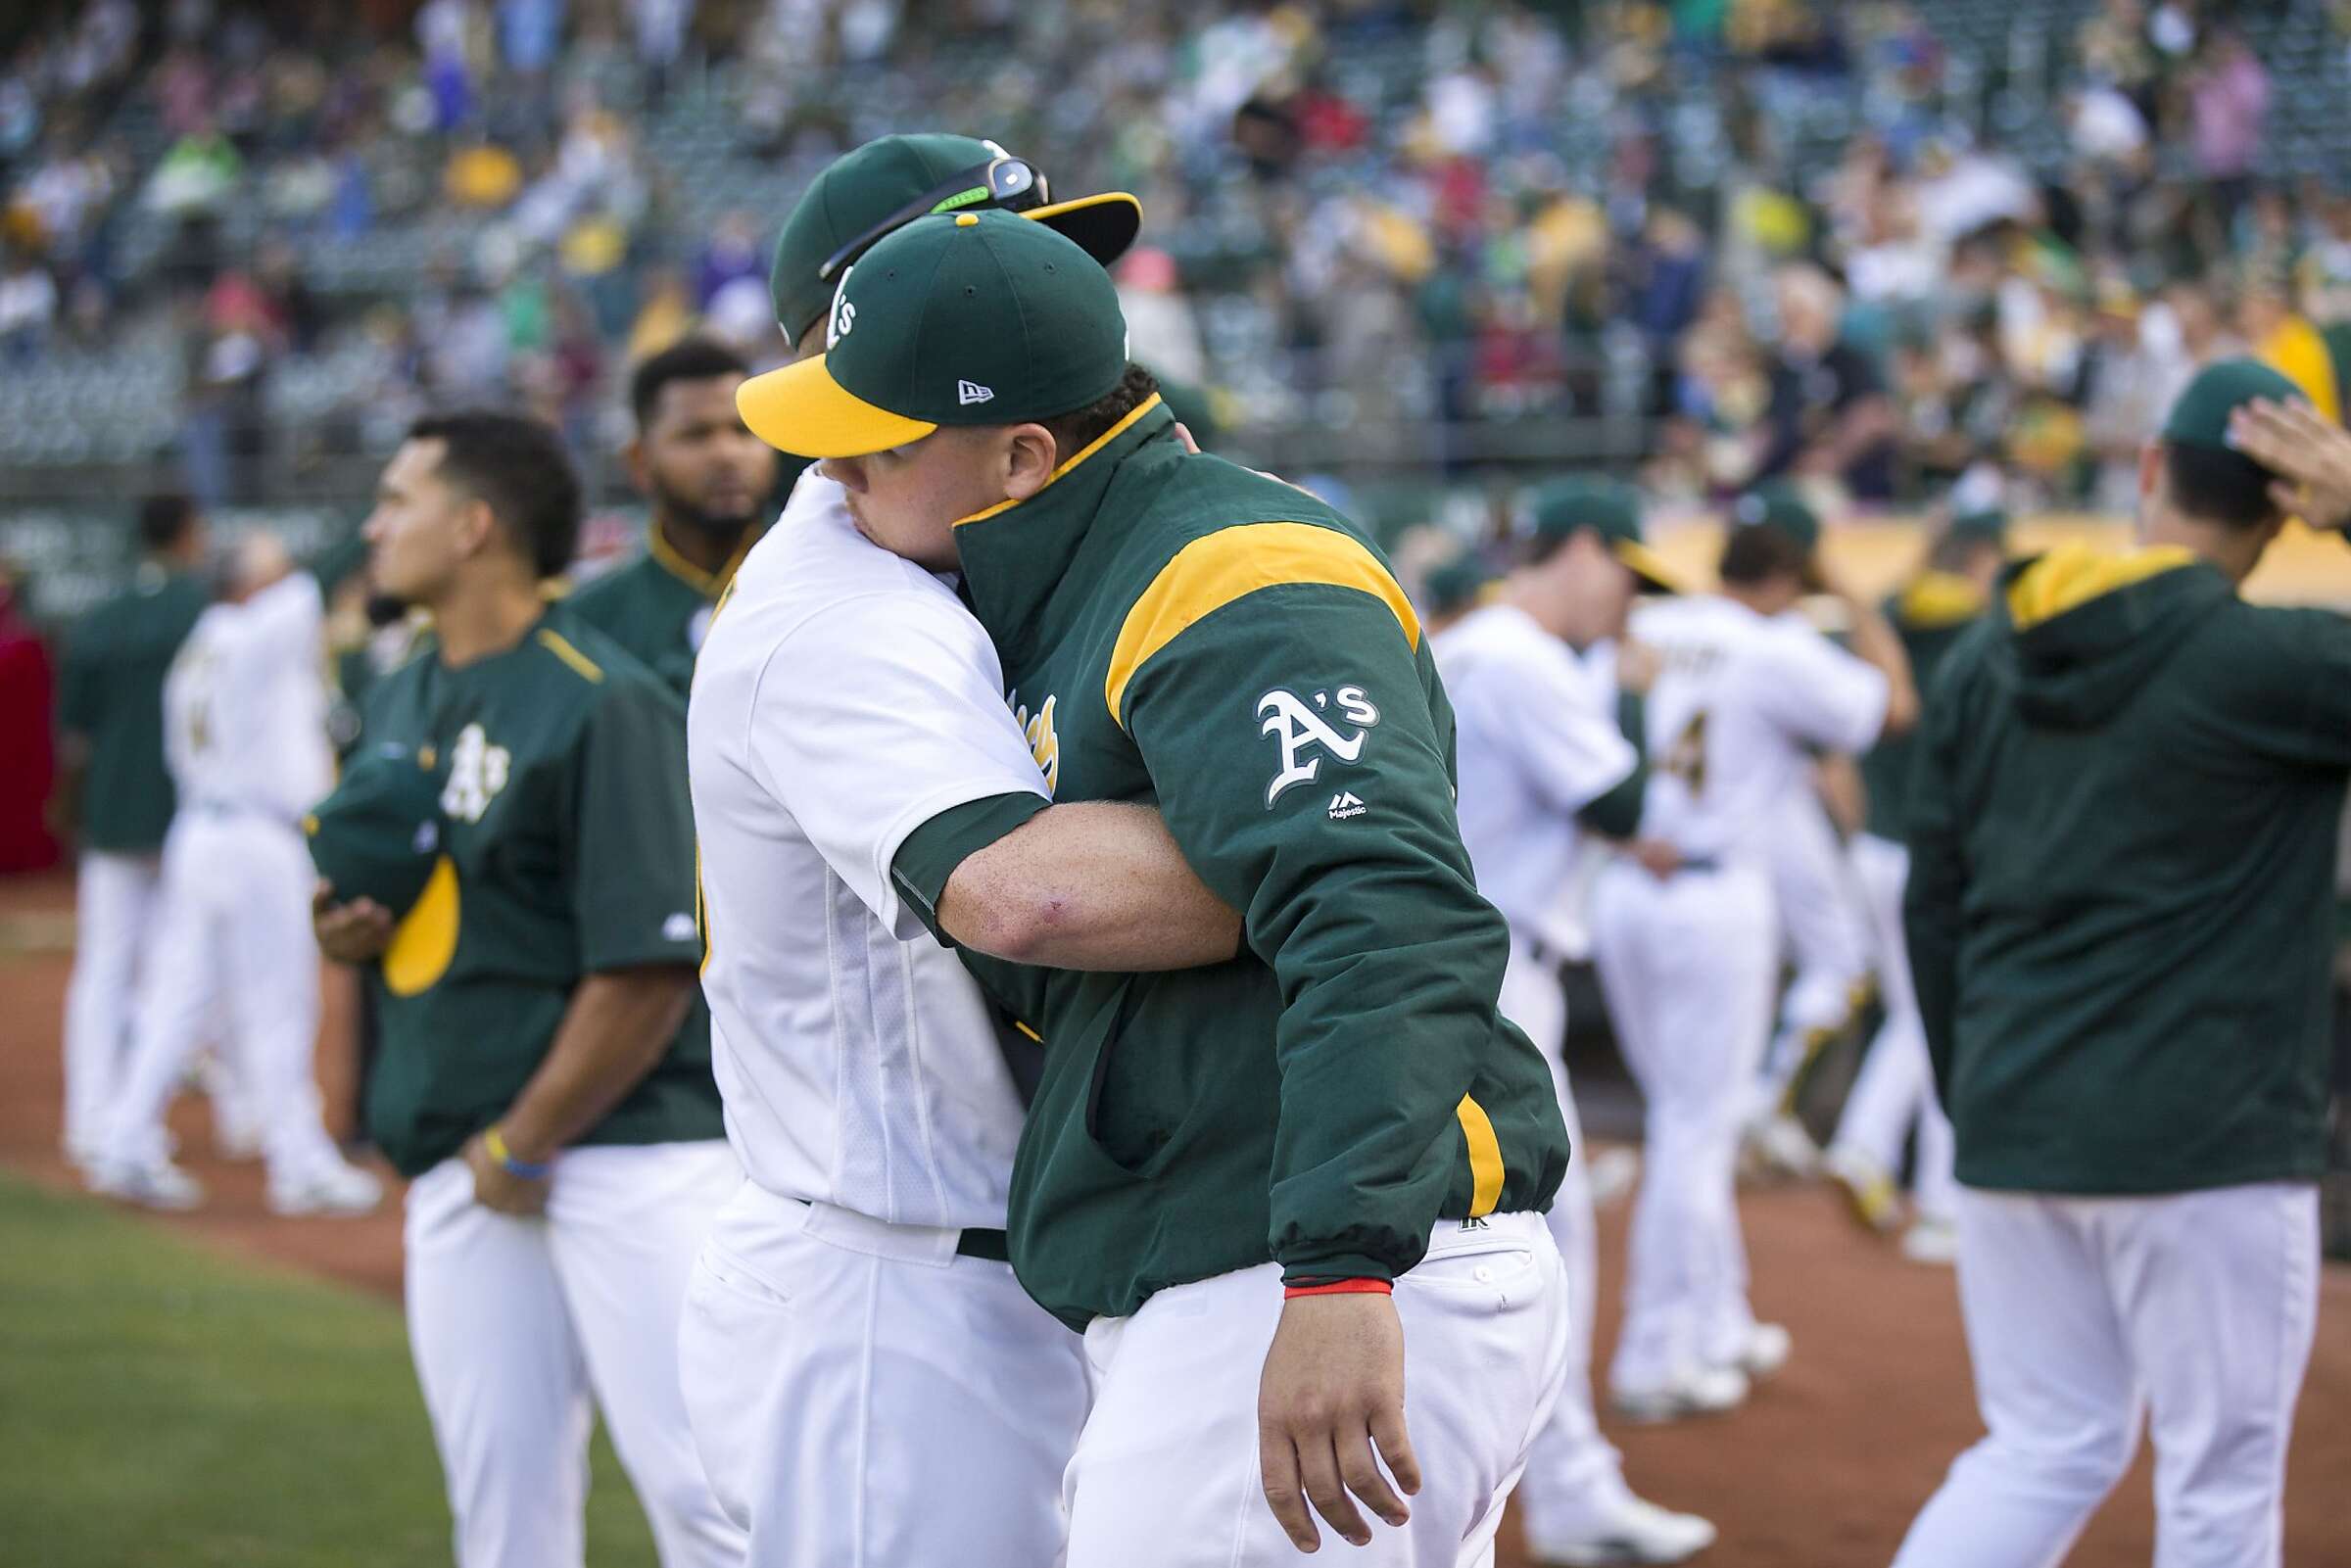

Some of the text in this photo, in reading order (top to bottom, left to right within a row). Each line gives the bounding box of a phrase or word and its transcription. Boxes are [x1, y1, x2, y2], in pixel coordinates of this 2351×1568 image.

[1257, 686, 1377, 806] A's
[1654, 707, 1706, 799] 4
[1328, 805, 1367, 820] Majestic
